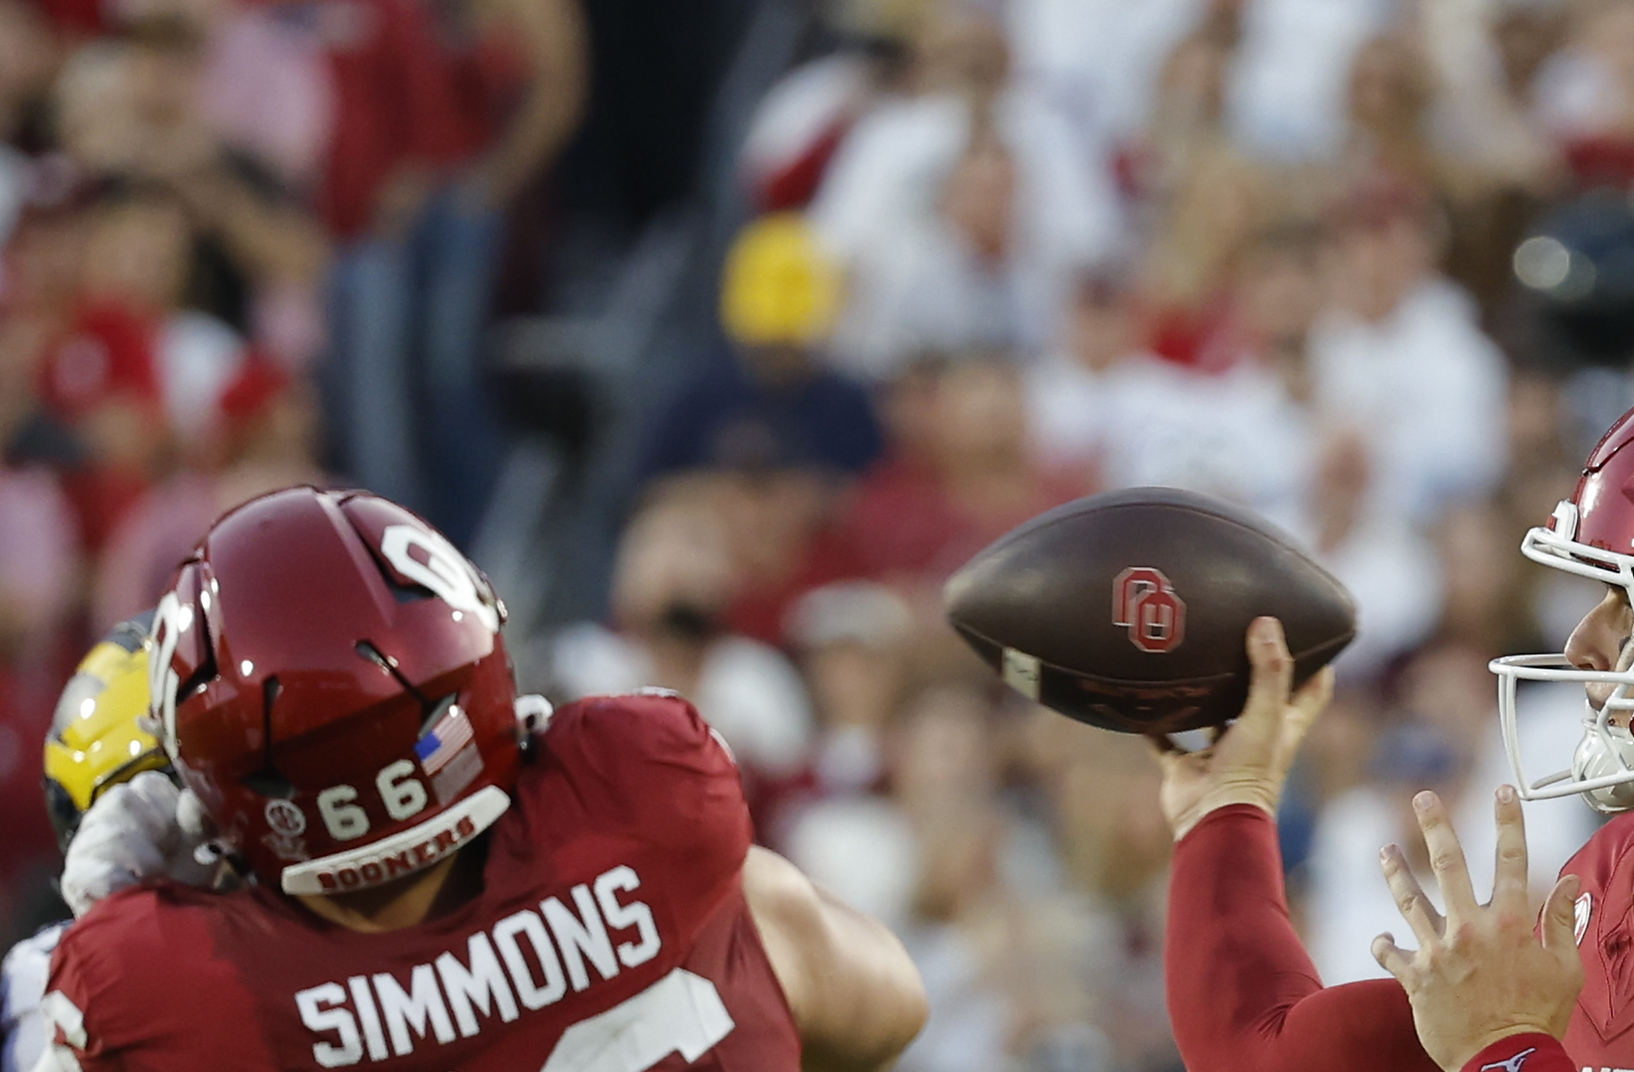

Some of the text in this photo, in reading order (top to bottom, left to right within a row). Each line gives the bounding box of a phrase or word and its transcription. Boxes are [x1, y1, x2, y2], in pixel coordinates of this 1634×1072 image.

[317, 759, 428, 841] 66
[317, 815, 476, 890] SOONERS
[296, 865, 662, 1068] SIMMONS
